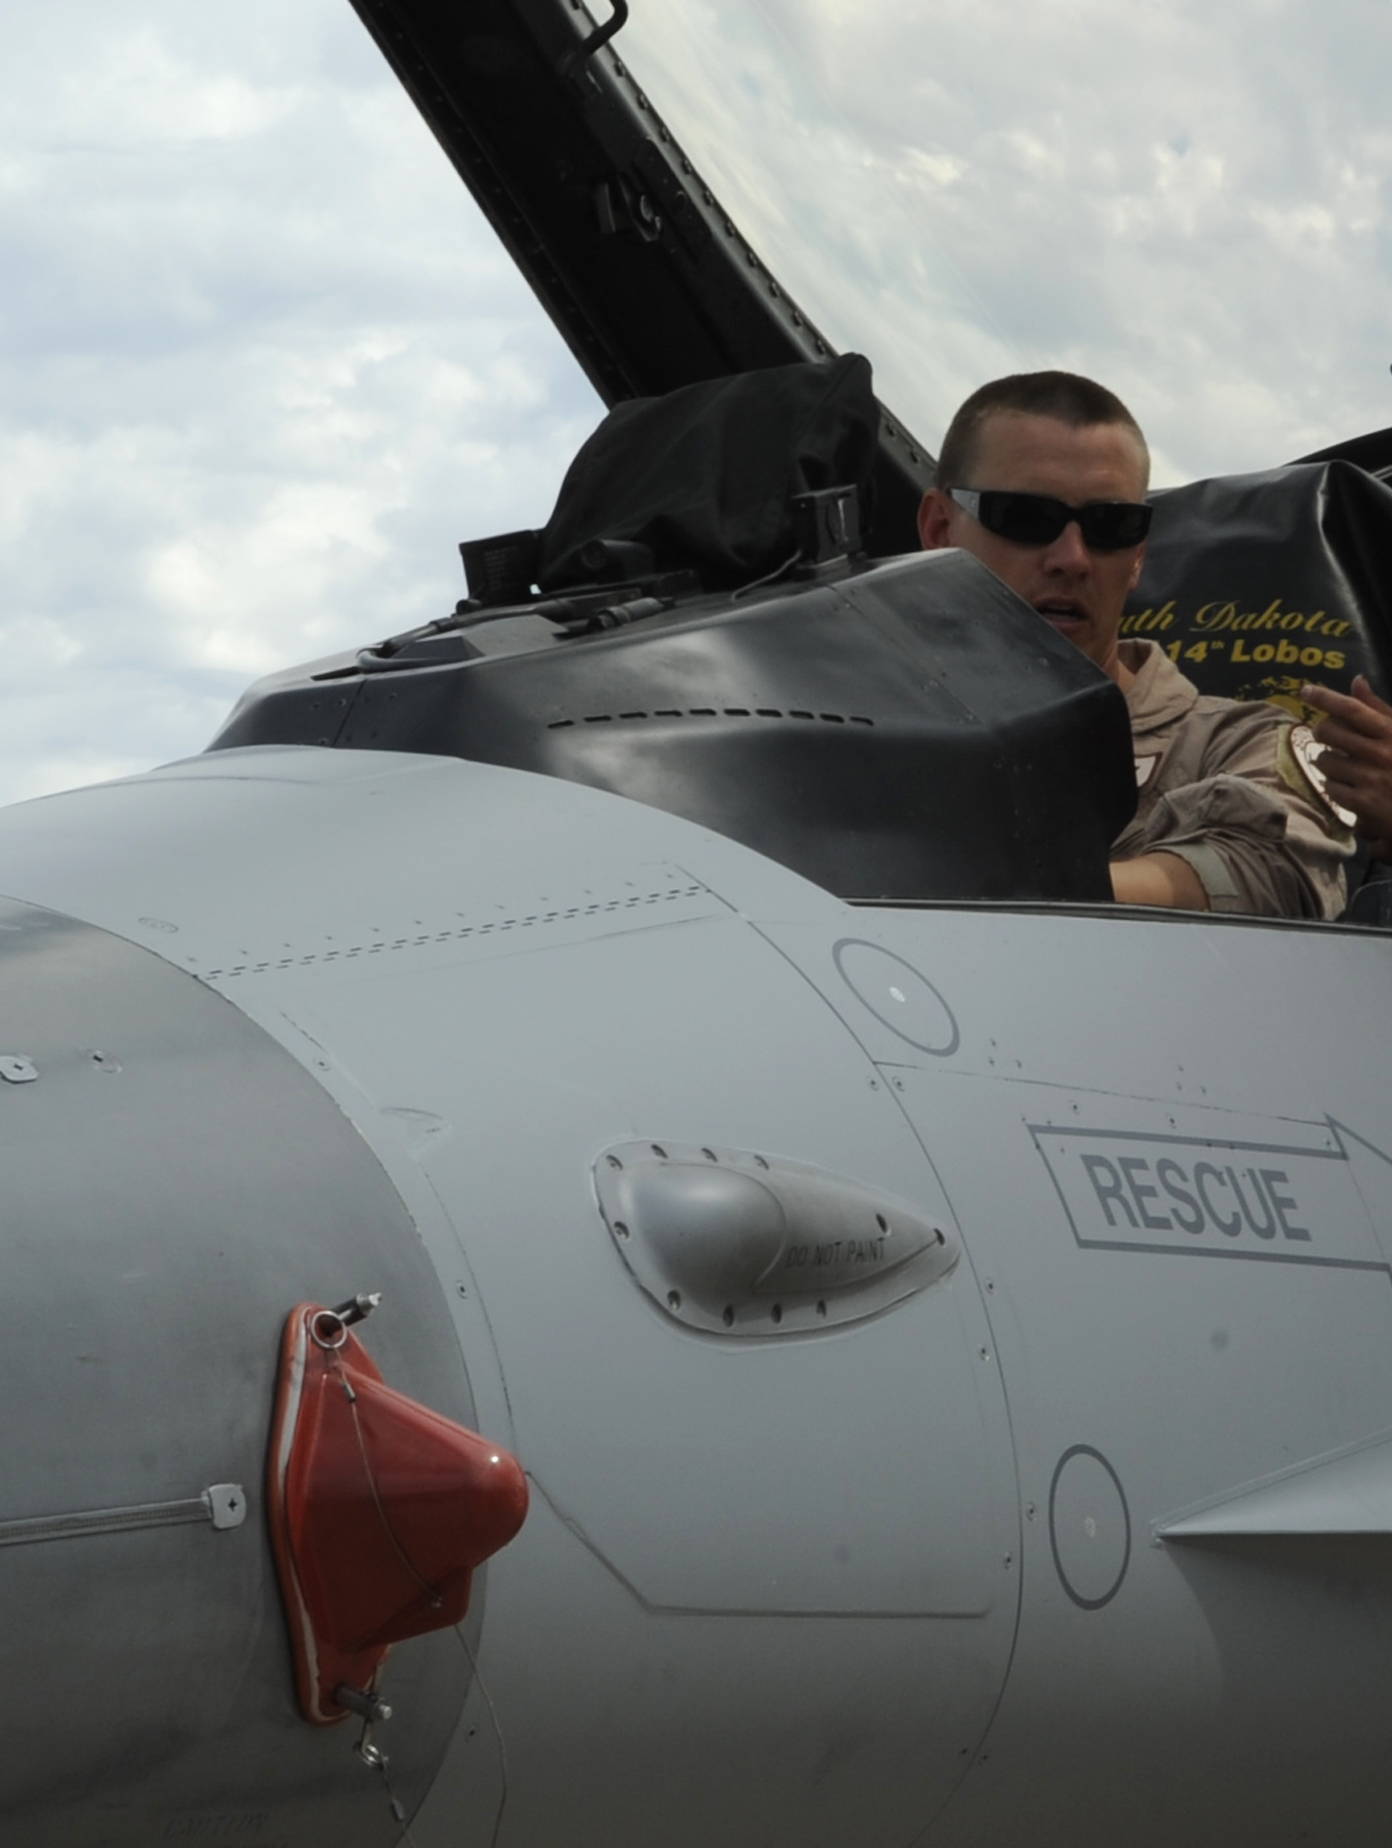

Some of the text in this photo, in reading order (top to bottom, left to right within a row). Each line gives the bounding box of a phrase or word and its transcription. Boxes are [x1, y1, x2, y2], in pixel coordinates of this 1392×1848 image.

[1117, 599, 1352, 638] uth Dakota
[1230, 639, 1346, 670] Lobos
[1080, 1153, 1312, 1242] RESCUE
[784, 1236, 885, 1269] DO NOT PAINT
